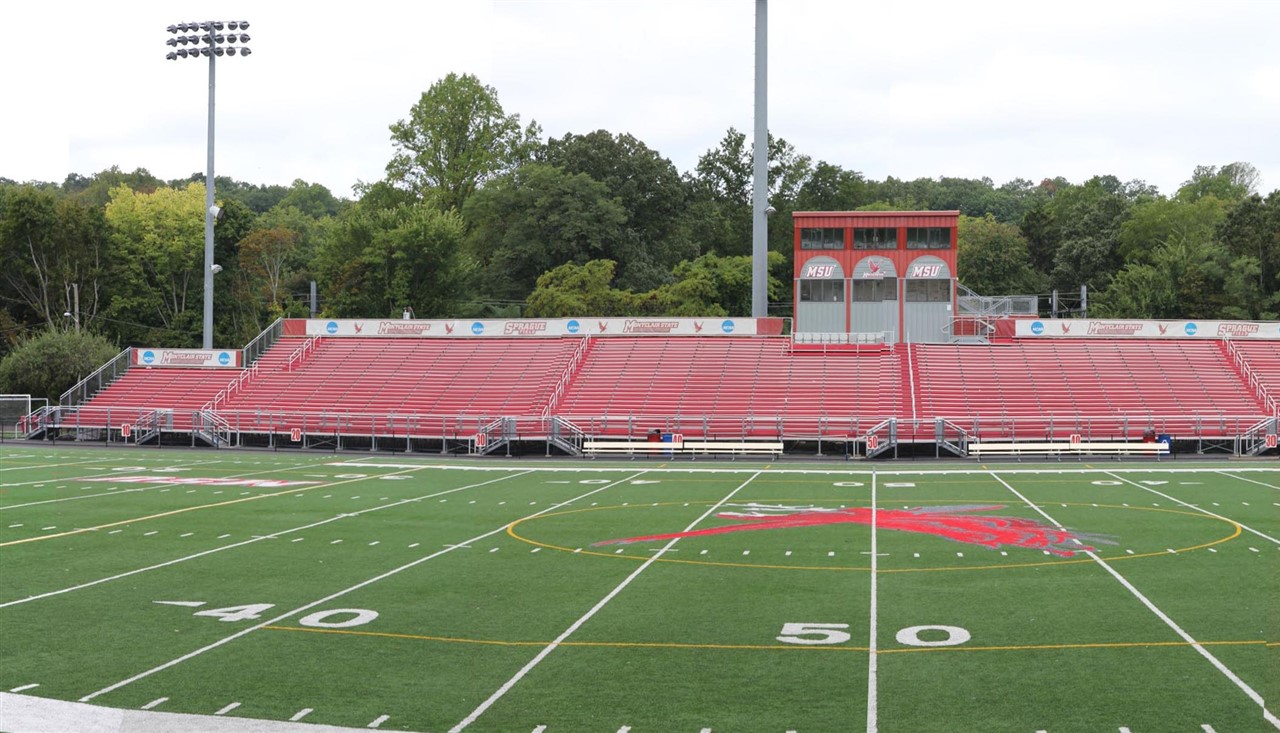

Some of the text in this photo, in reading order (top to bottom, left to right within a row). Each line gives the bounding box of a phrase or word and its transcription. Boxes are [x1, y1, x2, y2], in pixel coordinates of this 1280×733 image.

[806, 265, 834, 278] MSU
[912, 264, 940, 277] MSU
[504, 321, 547, 334] SPRAGUE
[1217, 323, 1259, 336] SPRAGUE
[122, 425, 130, 436] 10
[291, 429, 301, 440] 20
[476, 434, 485, 445] 30
[868, 436, 878, 448] 50
[1266, 435, 1276, 446] 30
